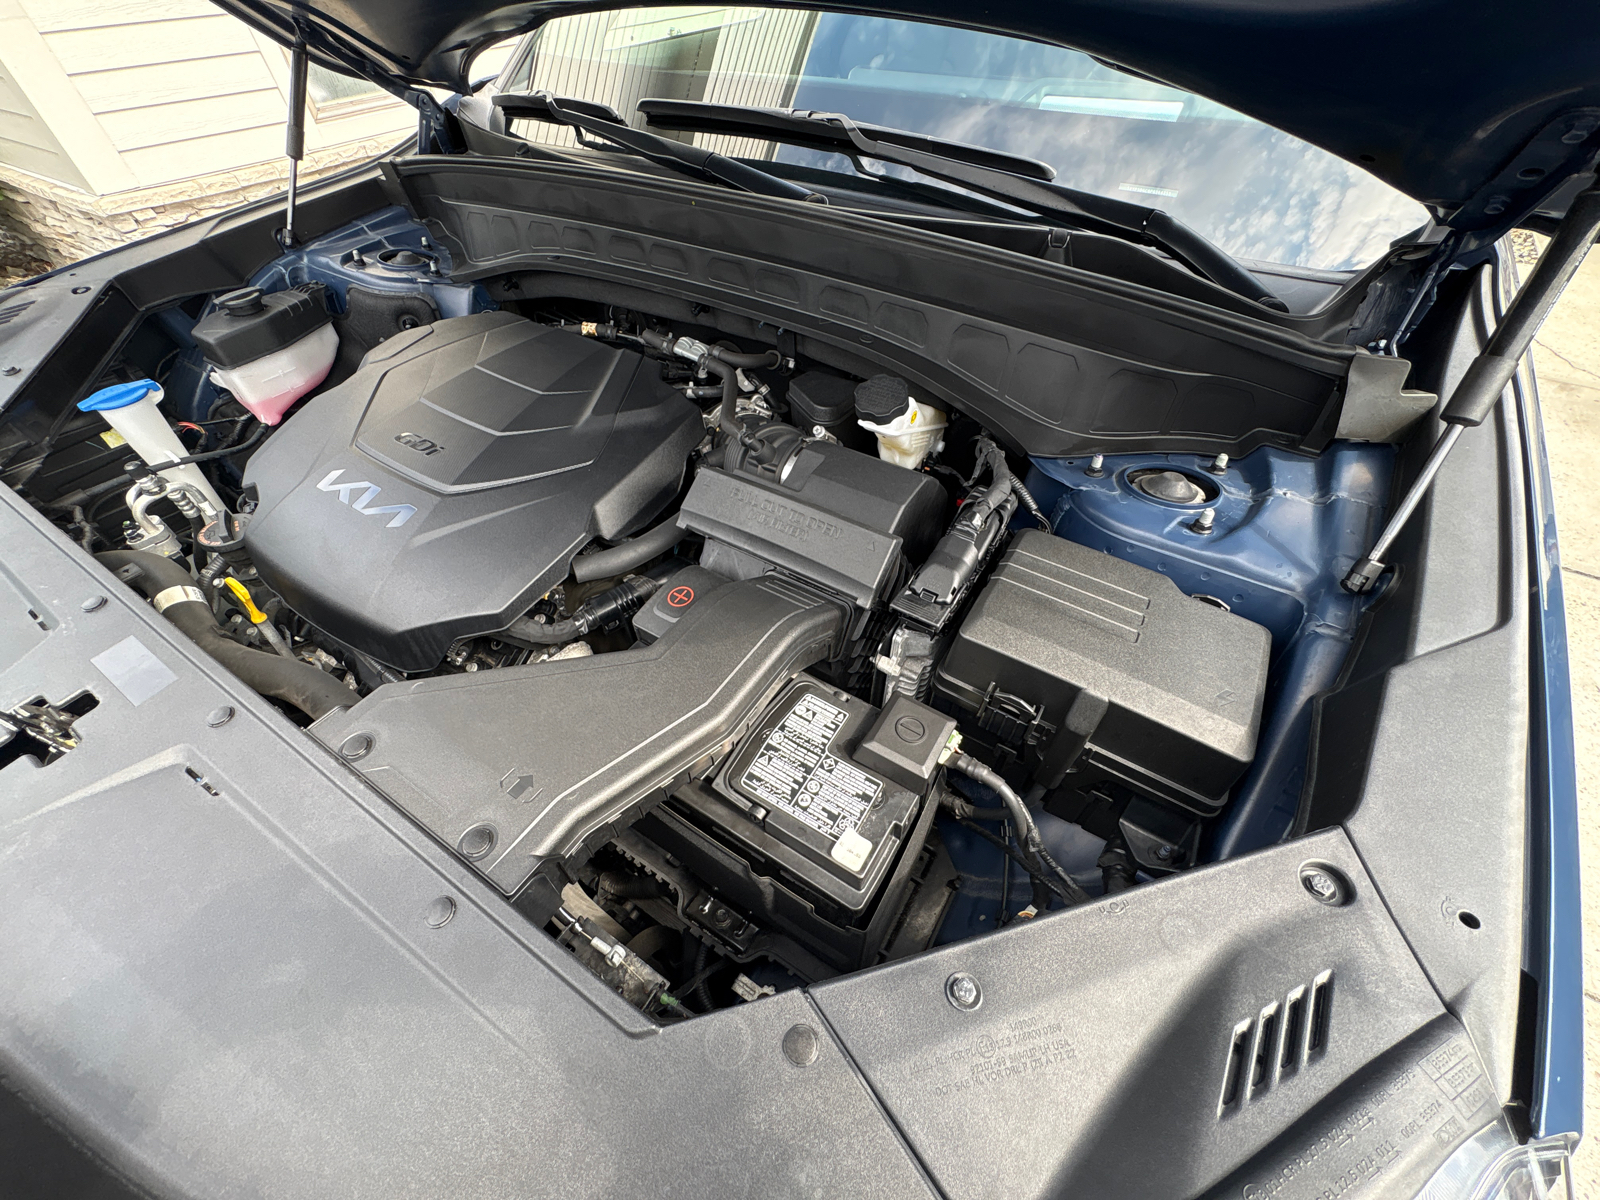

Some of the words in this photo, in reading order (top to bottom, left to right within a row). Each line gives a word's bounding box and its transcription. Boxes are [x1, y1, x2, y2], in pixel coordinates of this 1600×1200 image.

[760, 499, 786, 517] OUT
[787, 510, 804, 524] TO
[805, 517, 841, 539] OPEN
